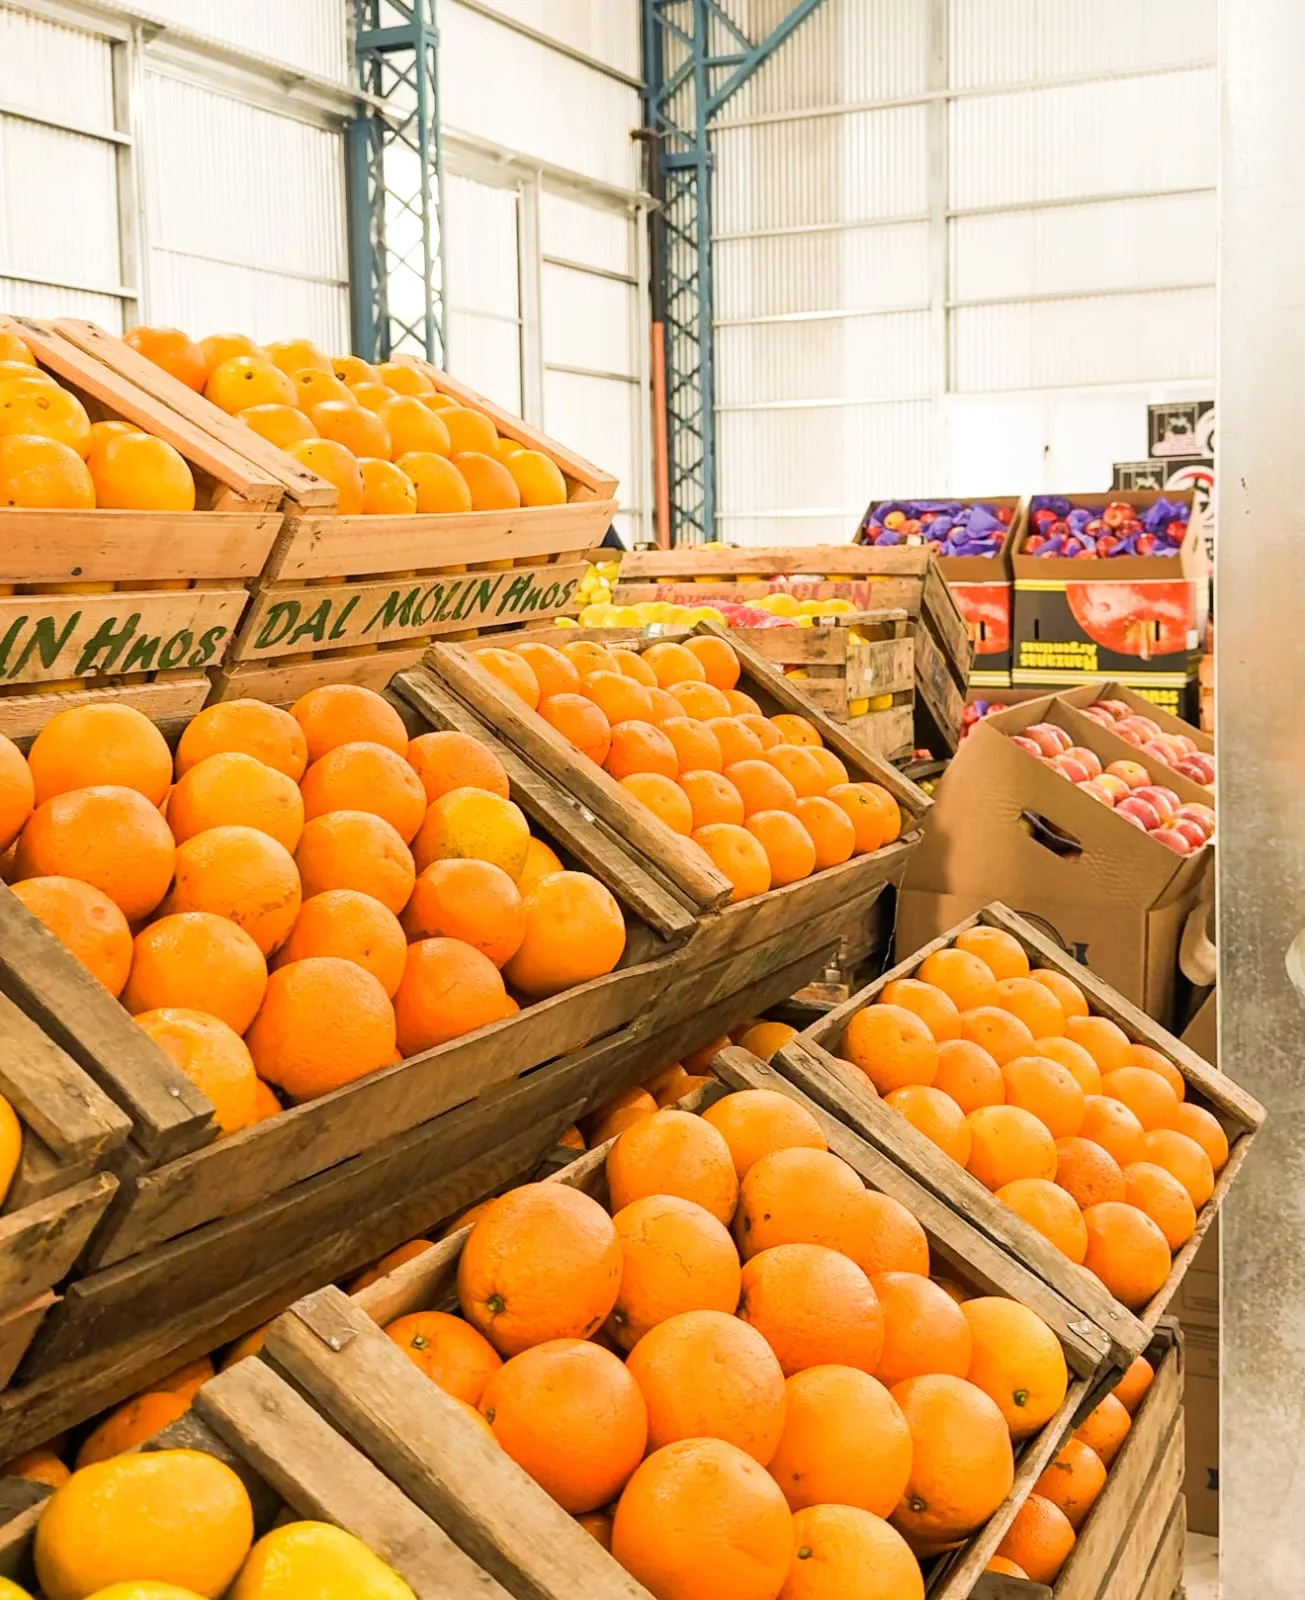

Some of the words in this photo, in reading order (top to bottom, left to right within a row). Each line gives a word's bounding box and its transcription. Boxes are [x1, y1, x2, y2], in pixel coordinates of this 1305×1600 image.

[254, 595, 361, 649] DAL
[495, 573, 578, 616] Hnos
[75, 613, 227, 676] Hnos
[1020, 653, 1098, 671] Manzanas
[1021, 641, 1097, 656] Argentinas
